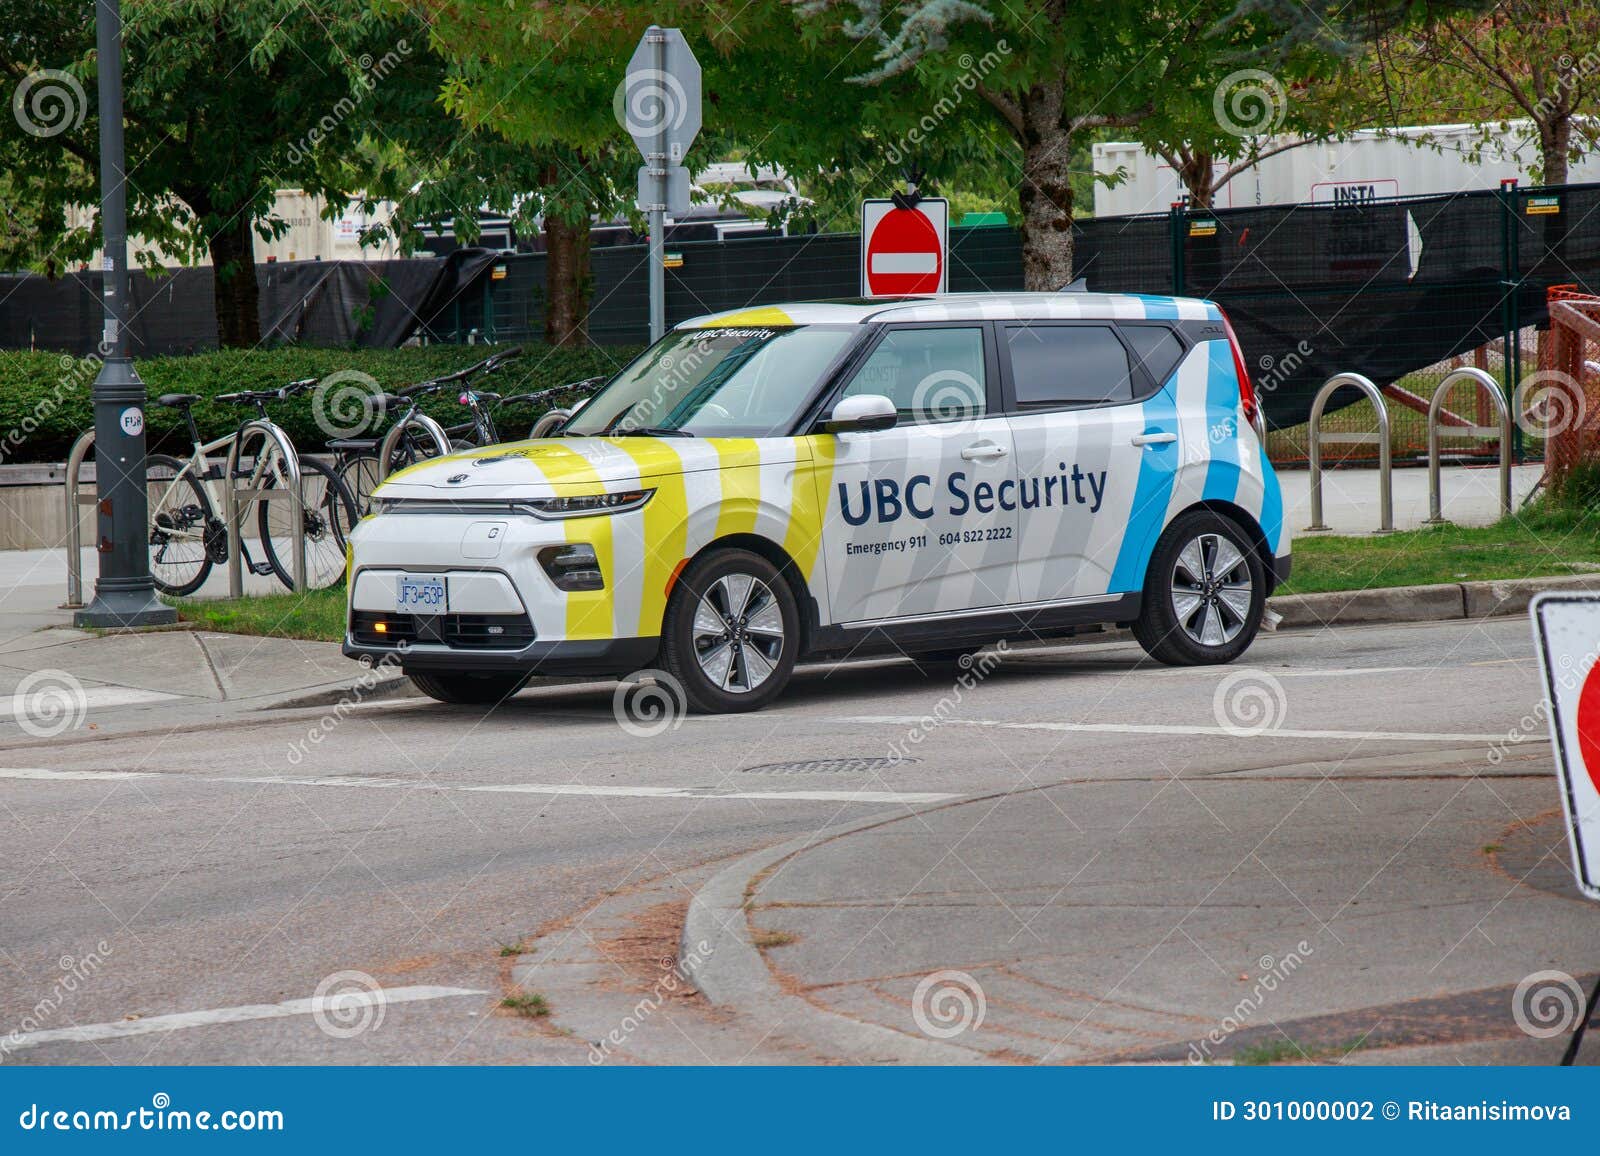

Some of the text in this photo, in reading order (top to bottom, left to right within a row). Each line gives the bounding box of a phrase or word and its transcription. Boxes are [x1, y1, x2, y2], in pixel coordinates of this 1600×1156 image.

[1334, 185, 1376, 207] INSTA
[693, 328, 776, 340] UBC Security
[838, 462, 1107, 526] UBC Security
[846, 527, 1012, 555] Emergency 911 604 822 2222
